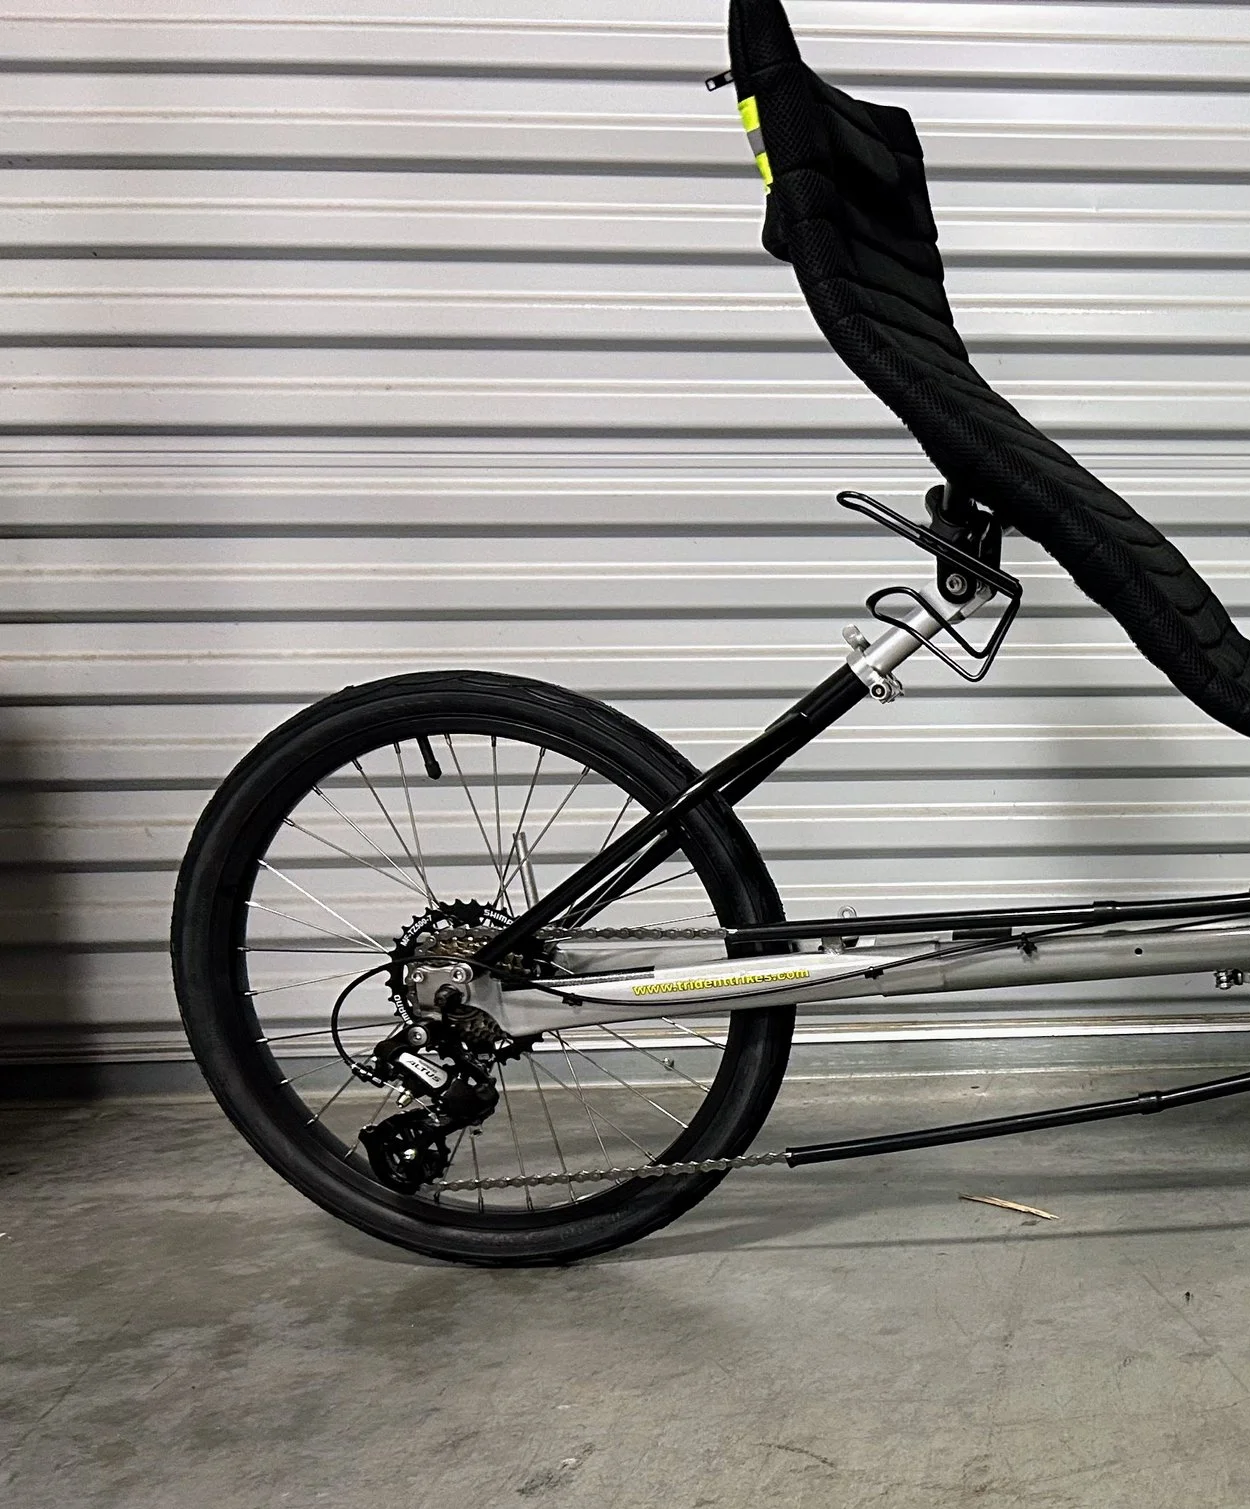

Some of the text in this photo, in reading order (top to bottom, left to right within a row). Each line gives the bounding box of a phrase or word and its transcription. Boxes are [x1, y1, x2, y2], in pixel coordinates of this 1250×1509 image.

[483, 908, 514, 926] SHIMA
[400, 914, 432, 947] MF-TZ500-7
[633, 970, 810, 995] www.tridenttrikes.com
[406, 1060, 441, 1082] ALTUS
